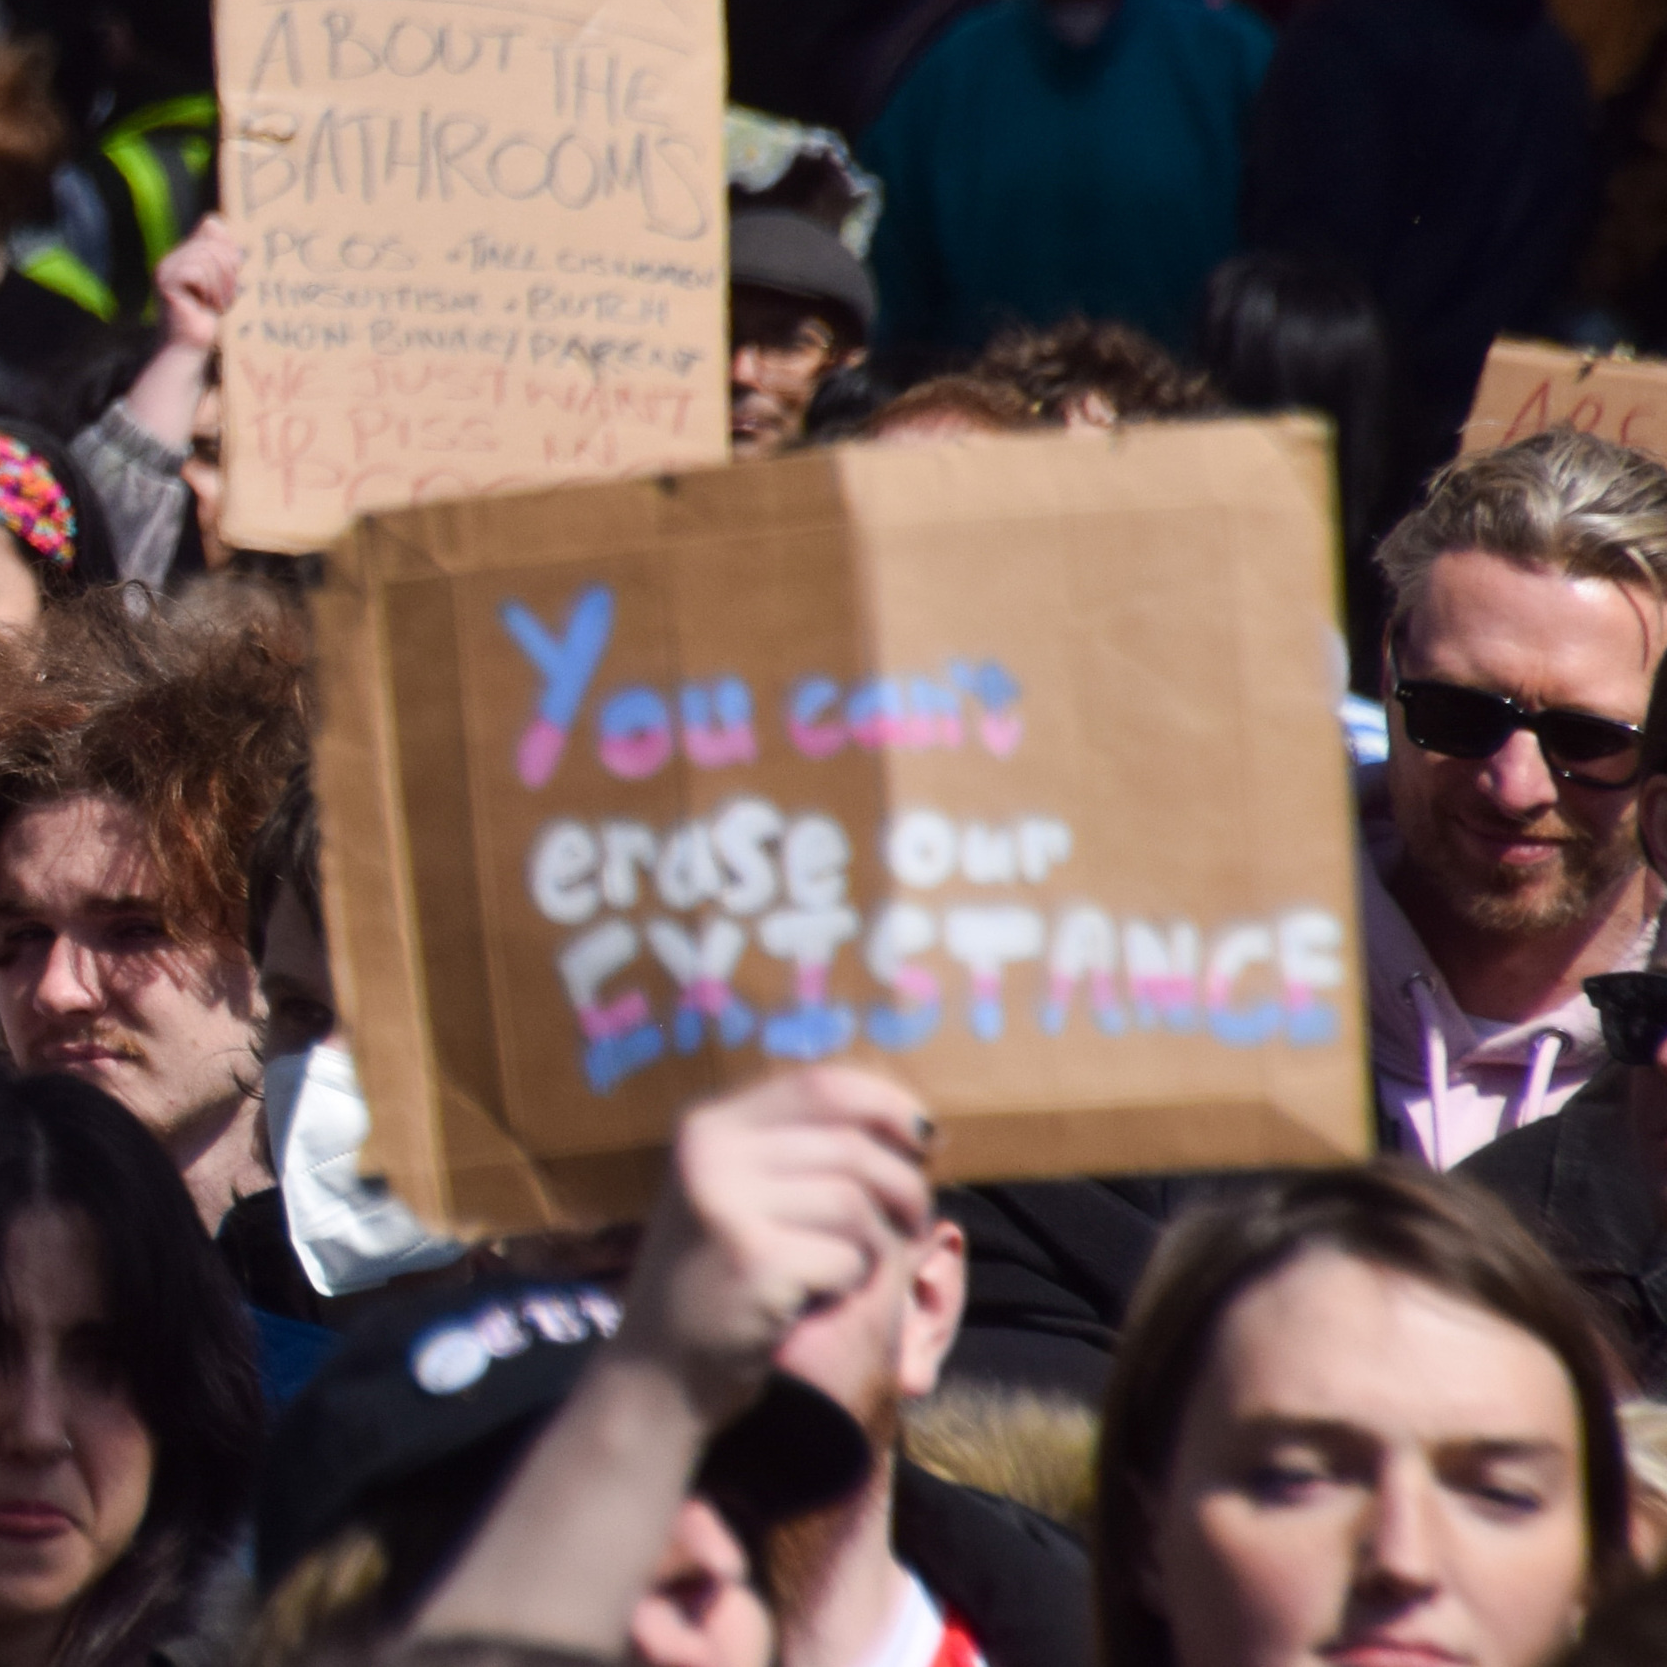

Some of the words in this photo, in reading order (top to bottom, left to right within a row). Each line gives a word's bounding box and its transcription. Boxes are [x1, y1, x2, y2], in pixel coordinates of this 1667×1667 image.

[250, 9, 525, 94] ABOUT
[540, 38, 677, 130] THE
[238, 109, 708, 241] BATHROOMS
[264, 228, 419, 272] PCOS
[497, 581, 759, 789] You
[787, 656, 1023, 761] can't
[527, 794, 855, 924] erase
[885, 806, 1074, 890] our
[555, 901, 1345, 1098] EXISTANCE
